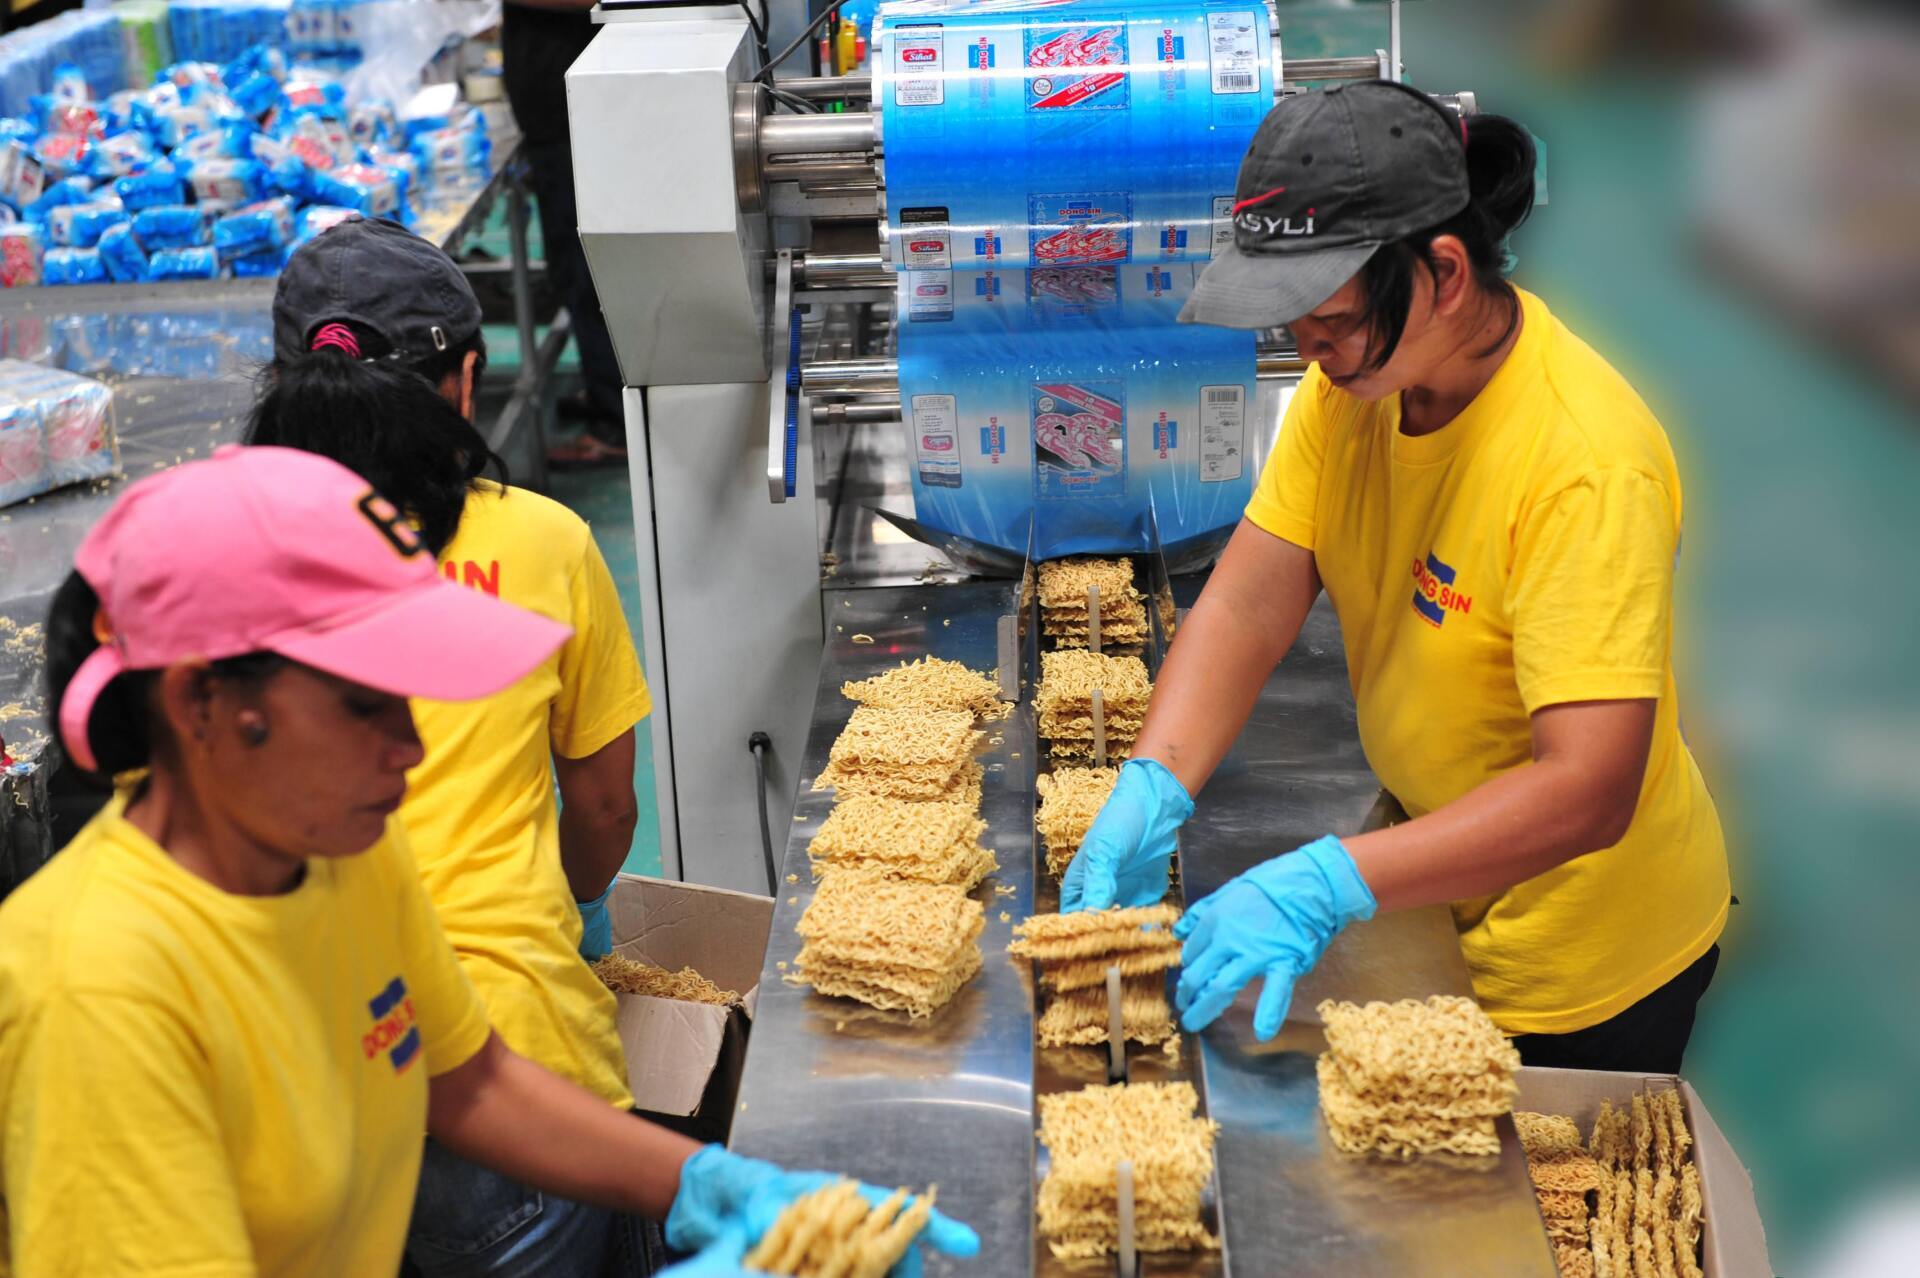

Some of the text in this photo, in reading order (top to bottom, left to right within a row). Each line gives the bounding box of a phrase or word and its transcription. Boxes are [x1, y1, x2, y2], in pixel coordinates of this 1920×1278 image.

[1163, 29, 1174, 53] DONG
[979, 51, 988, 71] ONG
[444, 560, 500, 599] IN
[1440, 587, 1472, 614] SIN
